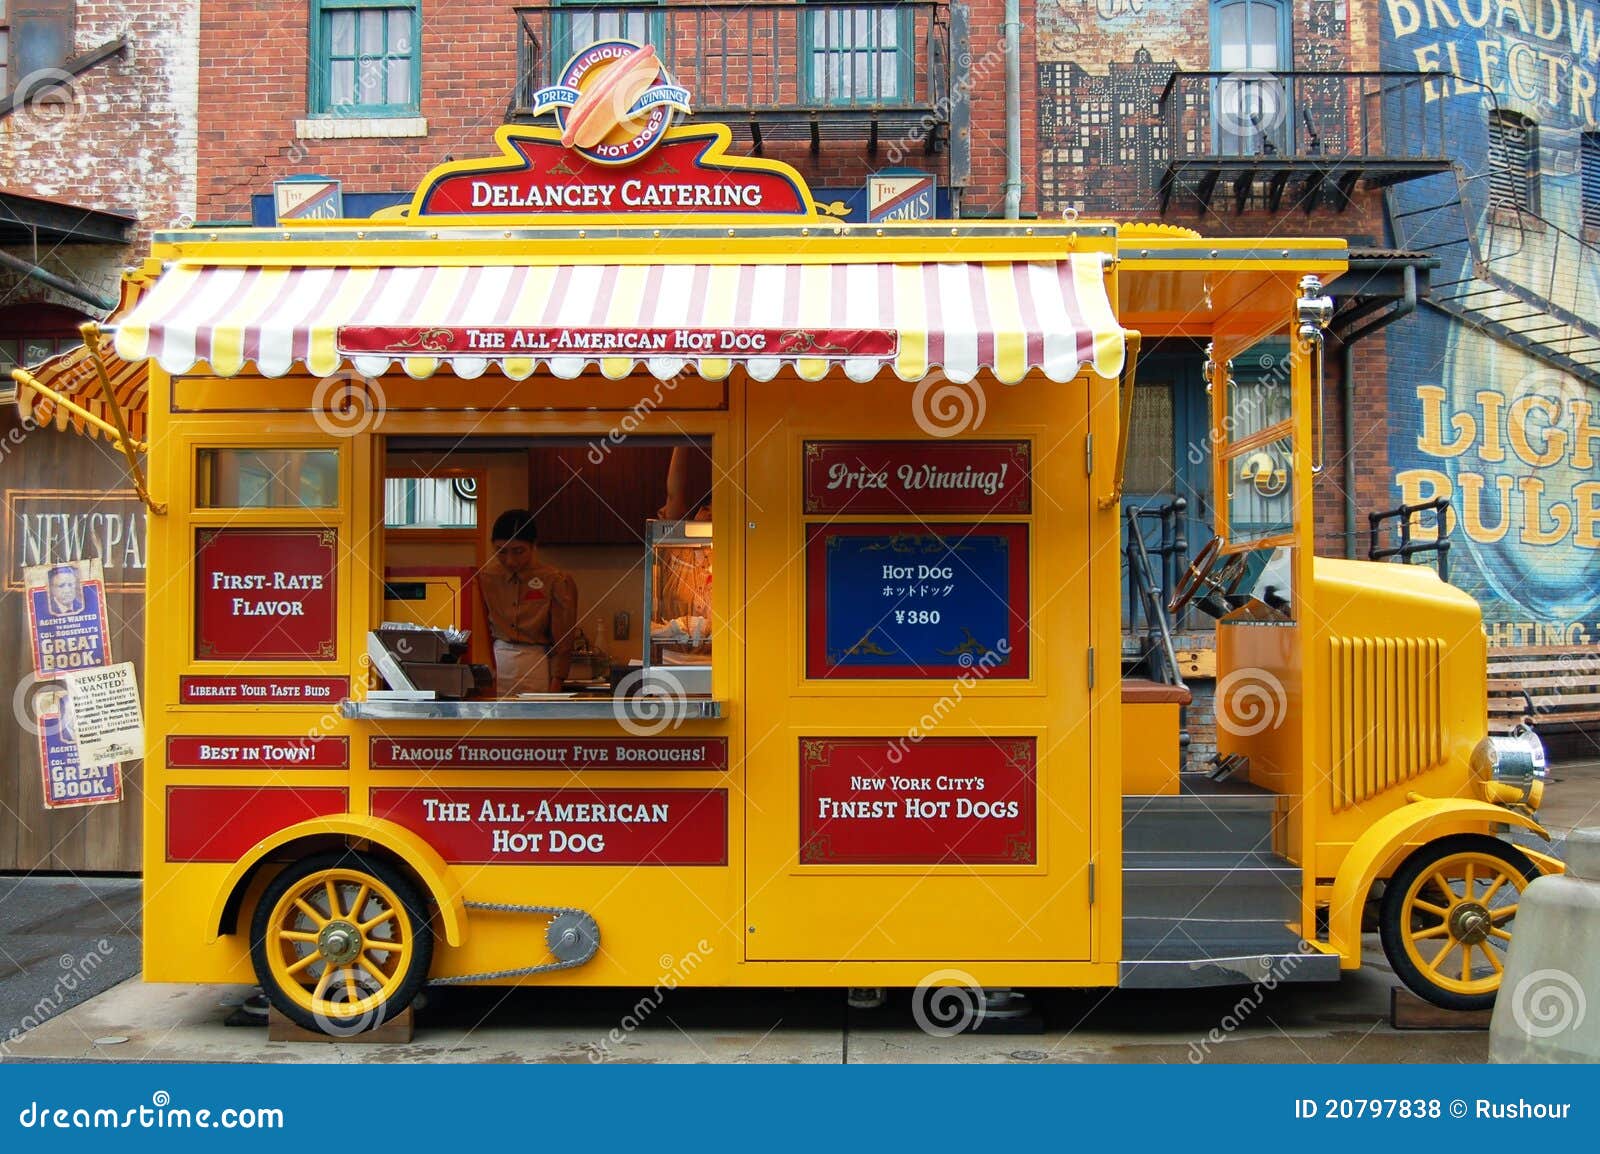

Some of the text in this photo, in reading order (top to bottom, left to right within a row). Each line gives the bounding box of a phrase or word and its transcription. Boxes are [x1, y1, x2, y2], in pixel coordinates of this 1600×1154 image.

[568, 47, 632, 88] DELICIOUS
[542, 90, 574, 103] PRIZE
[640, 89, 684, 106] WINNING
[596, 111, 663, 157] HOT DOGS
[471, 179, 762, 207] DELANCEY CATERING
[466, 329, 766, 350] THE ALL-AMERICAN HOT DOG
[826, 463, 1009, 495] Prize Winning!
[20, 513, 147, 568] NEWSPA
[212, 571, 323, 590] FIRST-RATE
[882, 565, 953, 579] HOT DOG
[882, 584, 954, 597] ホットドッグ
[232, 598, 304, 616] FLAVOR
[895, 610, 941, 624] ¥380
[41, 634, 99, 655] GREAT
[43, 650, 102, 670] BOOK.
[76, 669, 127, 685] NEWSBOYS
[189, 684, 330, 697] LIBERATE YOUR TASTE BUDS
[200, 744, 316, 760] BEST IN TOWN!
[391, 745, 706, 762] FAMOUS THROUGHOUT FIVE BOROUGHS!
[52, 764, 109, 781] GREAT
[53, 779, 113, 798] BOOK.
[850, 776, 985, 790] NEW YORK CITY'S
[423, 799, 669, 823] THE ALL-AMERICAN
[818, 797, 1019, 819] FINEST HOT DOGS
[492, 829, 605, 853] HOT DOG
